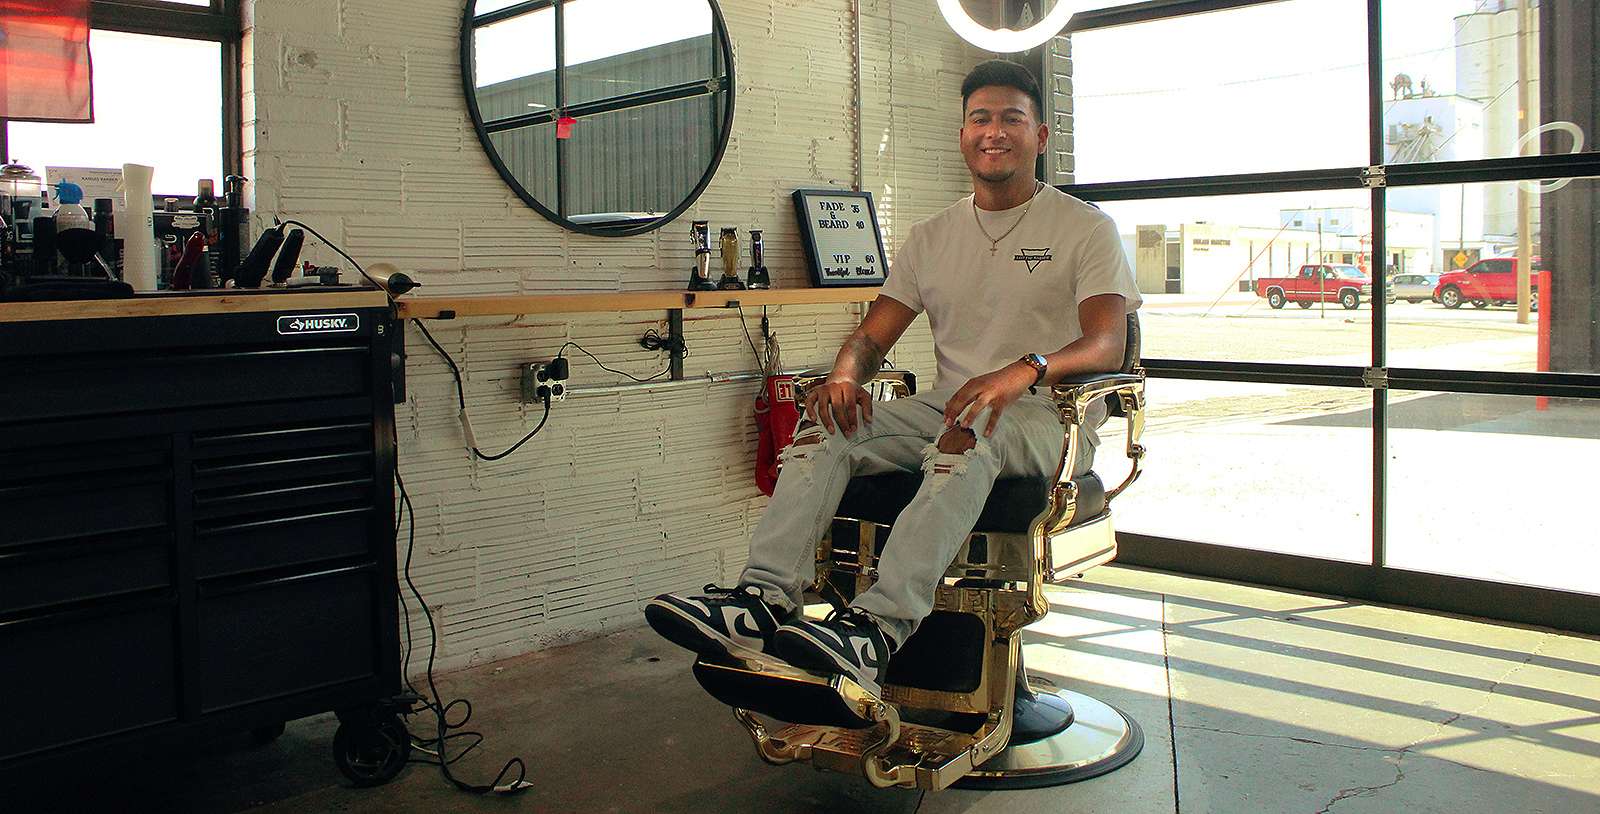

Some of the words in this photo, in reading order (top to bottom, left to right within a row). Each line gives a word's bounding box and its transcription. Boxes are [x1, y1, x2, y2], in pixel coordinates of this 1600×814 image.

[819, 201, 845, 211] FADE
[830, 211, 836, 219] &
[818, 219, 849, 229] BEARD
[856, 220, 865, 229] 40
[833, 255, 851, 264] VIP
[865, 254, 875, 263] 60
